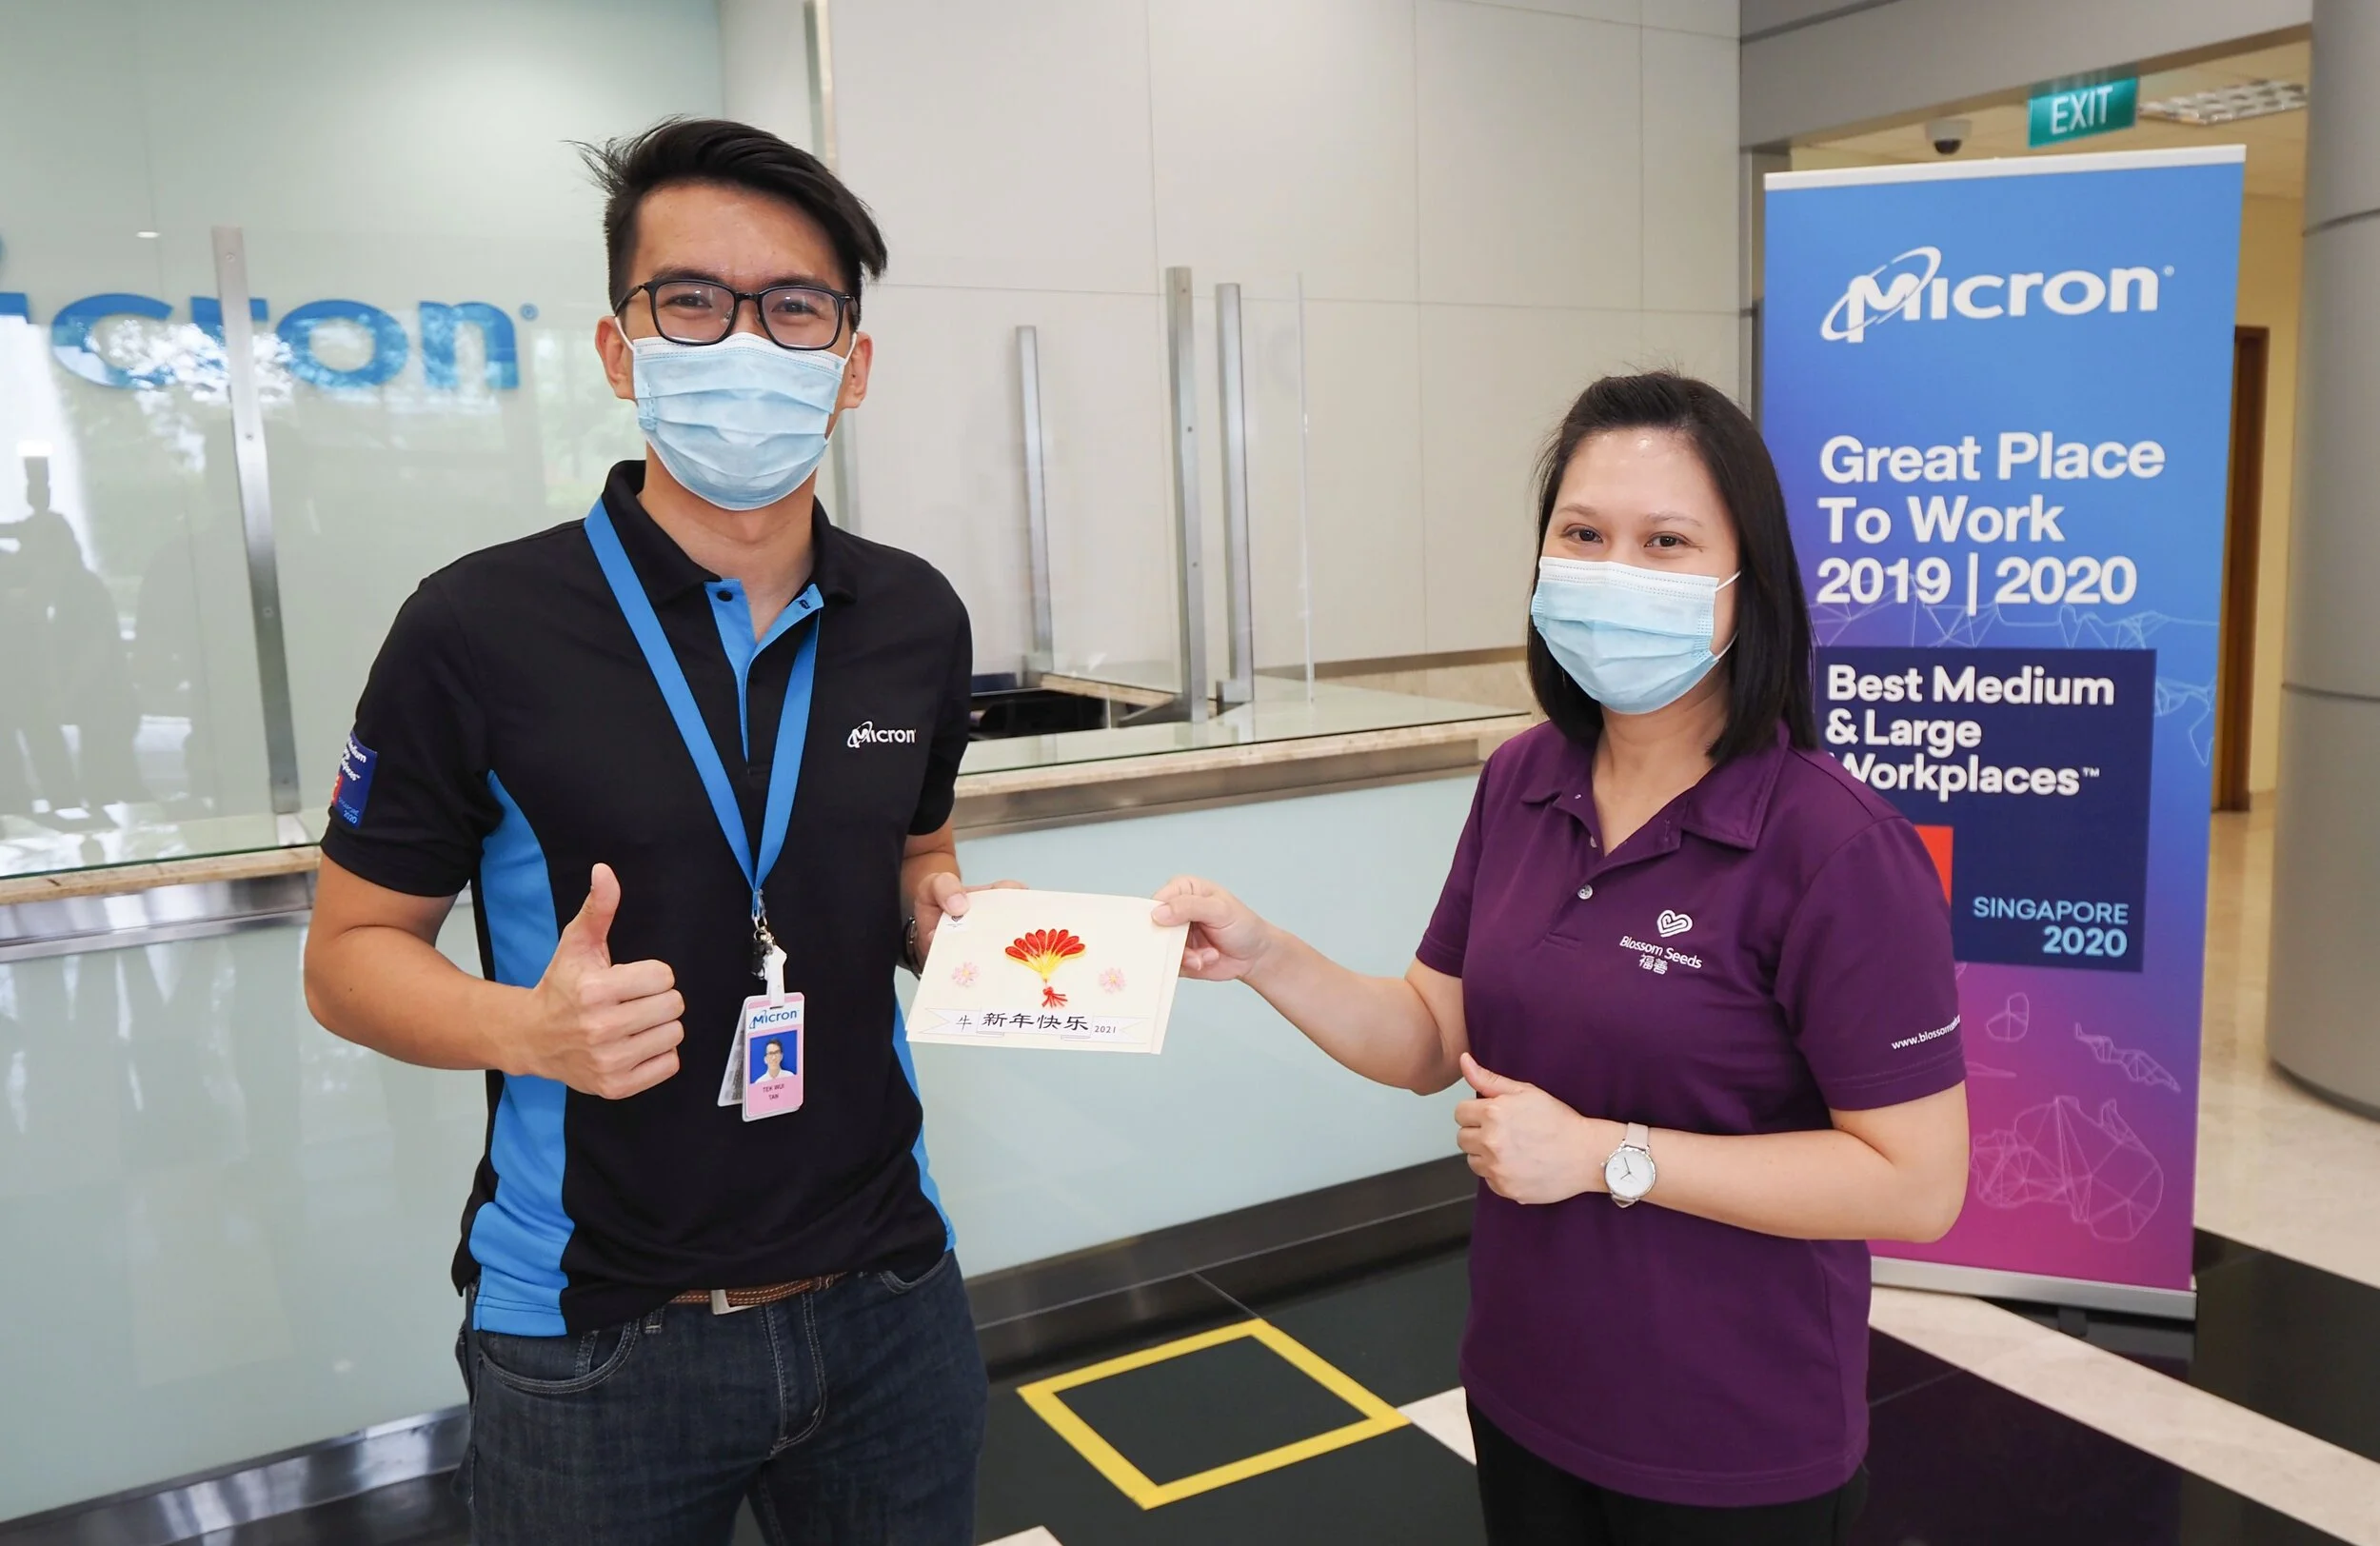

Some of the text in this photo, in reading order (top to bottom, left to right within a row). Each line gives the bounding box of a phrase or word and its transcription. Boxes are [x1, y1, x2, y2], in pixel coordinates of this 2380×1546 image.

[2052, 85, 2113, 135] EXIT
[1819, 430, 2166, 485] Great Place
[1816, 493, 2066, 545] To Work
[1815, 556, 1953, 605] 2019
[1995, 555, 2138, 606] 2020
[1827, 664, 2116, 706] Best Medium
[1824, 707, 1983, 759] & Large
[1973, 896, 2130, 926] SINGAPORE
[1618, 935, 1703, 969] Blossom Seeds
[2041, 924, 2129, 959] 2020
[955, 1012, 1117, 1034] 牛 新年快乐 2021
